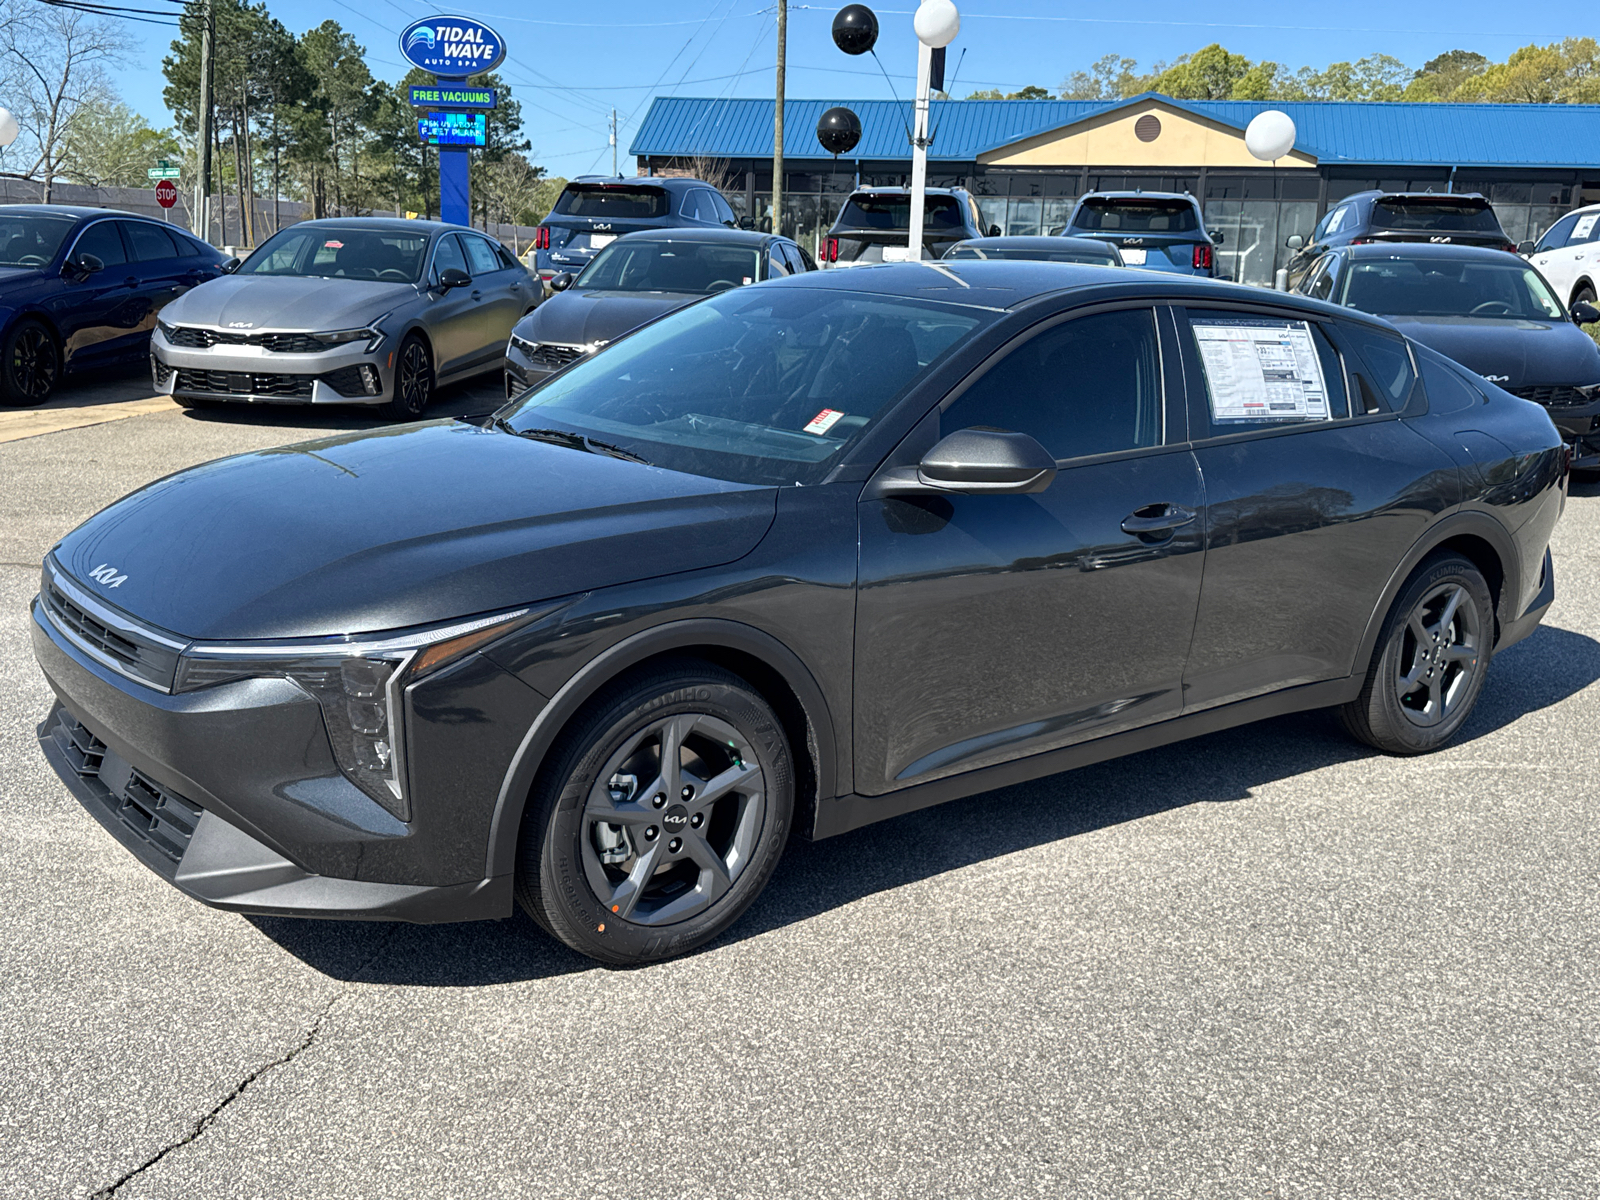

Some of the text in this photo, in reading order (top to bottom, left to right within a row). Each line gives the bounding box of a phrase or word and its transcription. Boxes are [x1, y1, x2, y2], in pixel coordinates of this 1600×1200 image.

[436, 26, 484, 43] TIDAL
[444, 42, 494, 59] WAVE
[424, 58, 451, 66] AUTO
[413, 90, 491, 103] FREE VACUUMS
[156, 188, 176, 200] STOP
[89, 563, 128, 589] KIA
[634, 687, 711, 717] KUMHO
